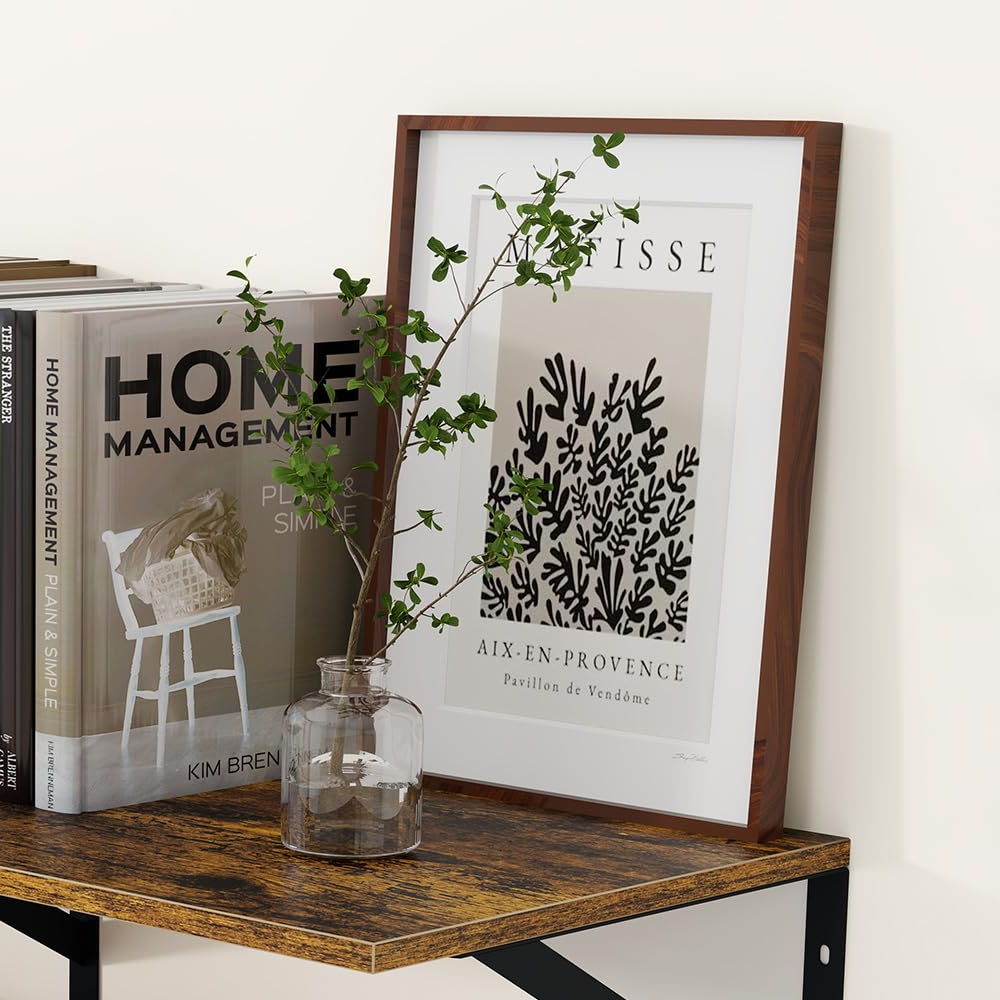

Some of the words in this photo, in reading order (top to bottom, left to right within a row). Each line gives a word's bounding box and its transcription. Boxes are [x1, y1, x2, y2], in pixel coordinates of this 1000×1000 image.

[506, 234, 717, 273] MTISSE
[1, 325, 13, 353] THE
[1, 356, 13, 424] STRANGER
[45, 357, 58, 417] HOME
[104, 340, 360, 421] HOME
[104, 411, 358, 458] MANAGEMENT
[44, 419, 58, 566] MANAGEMENT
[343, 477, 356, 498] &
[44, 574, 57, 624] PLAIN
[45, 629, 57, 641] &
[44, 647, 57, 709] SIMPLE
[476, 638, 686, 683] AIX-EN-PROVENCE
[503, 672, 560, 695] Pavillon
[566, 680, 582, 696] de
[588, 684, 651, 706] Vendôme
[188, 760, 221, 781] KIM
